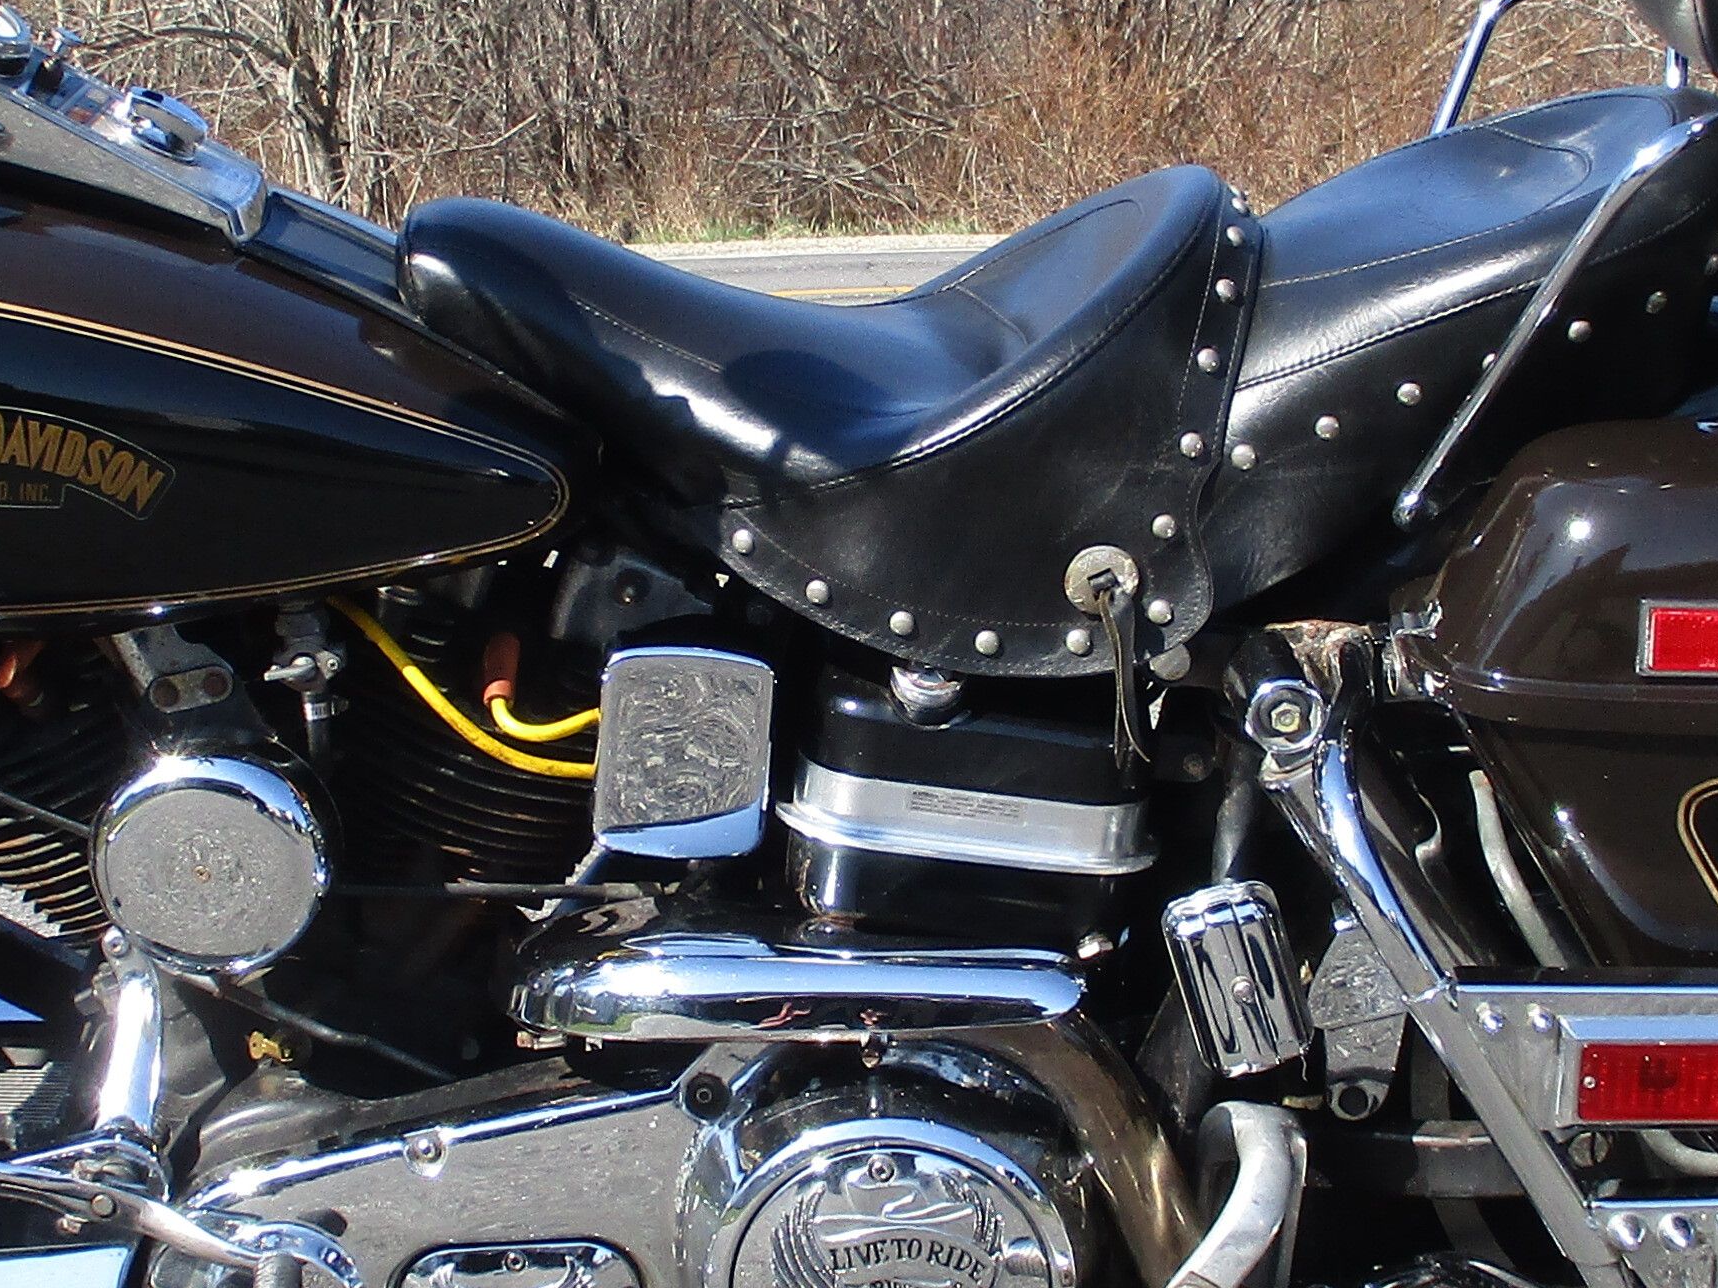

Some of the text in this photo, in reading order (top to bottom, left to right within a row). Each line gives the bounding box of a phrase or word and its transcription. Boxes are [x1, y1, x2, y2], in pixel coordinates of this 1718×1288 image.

[19, 481, 52, 503] INC.
[829, 1239, 889, 1270] LIVE
[891, 1238, 923, 1261] TO
